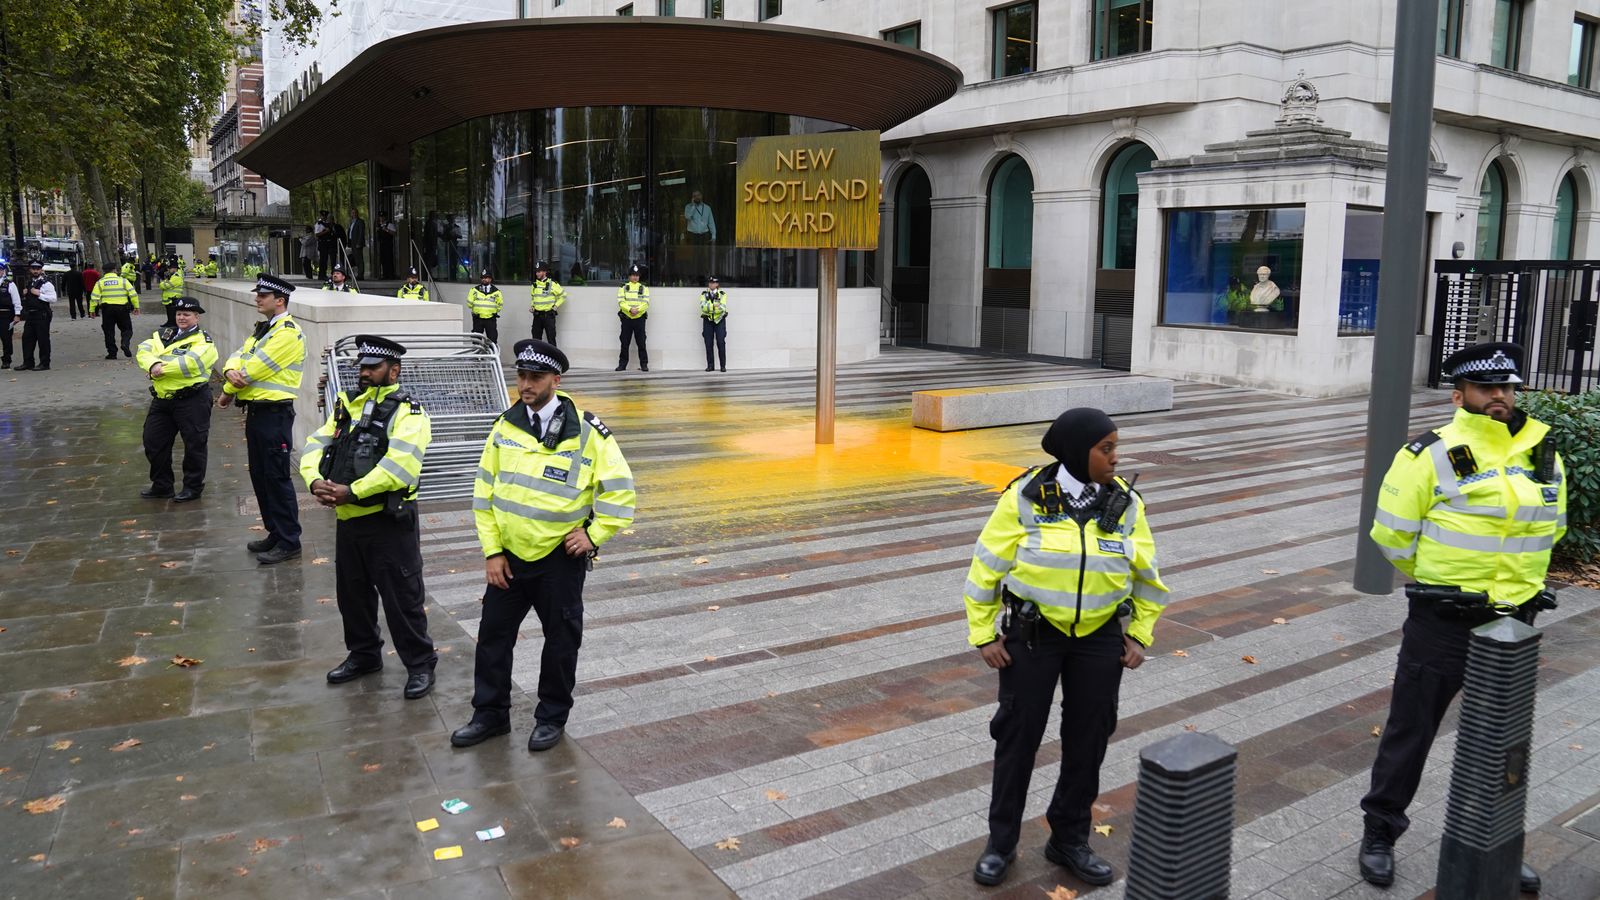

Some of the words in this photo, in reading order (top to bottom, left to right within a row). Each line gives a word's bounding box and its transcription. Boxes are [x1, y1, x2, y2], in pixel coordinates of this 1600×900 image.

[776, 147, 835, 171] NEW
[743, 179, 869, 203] SCOTLAND
[772, 212, 835, 233] YARD
